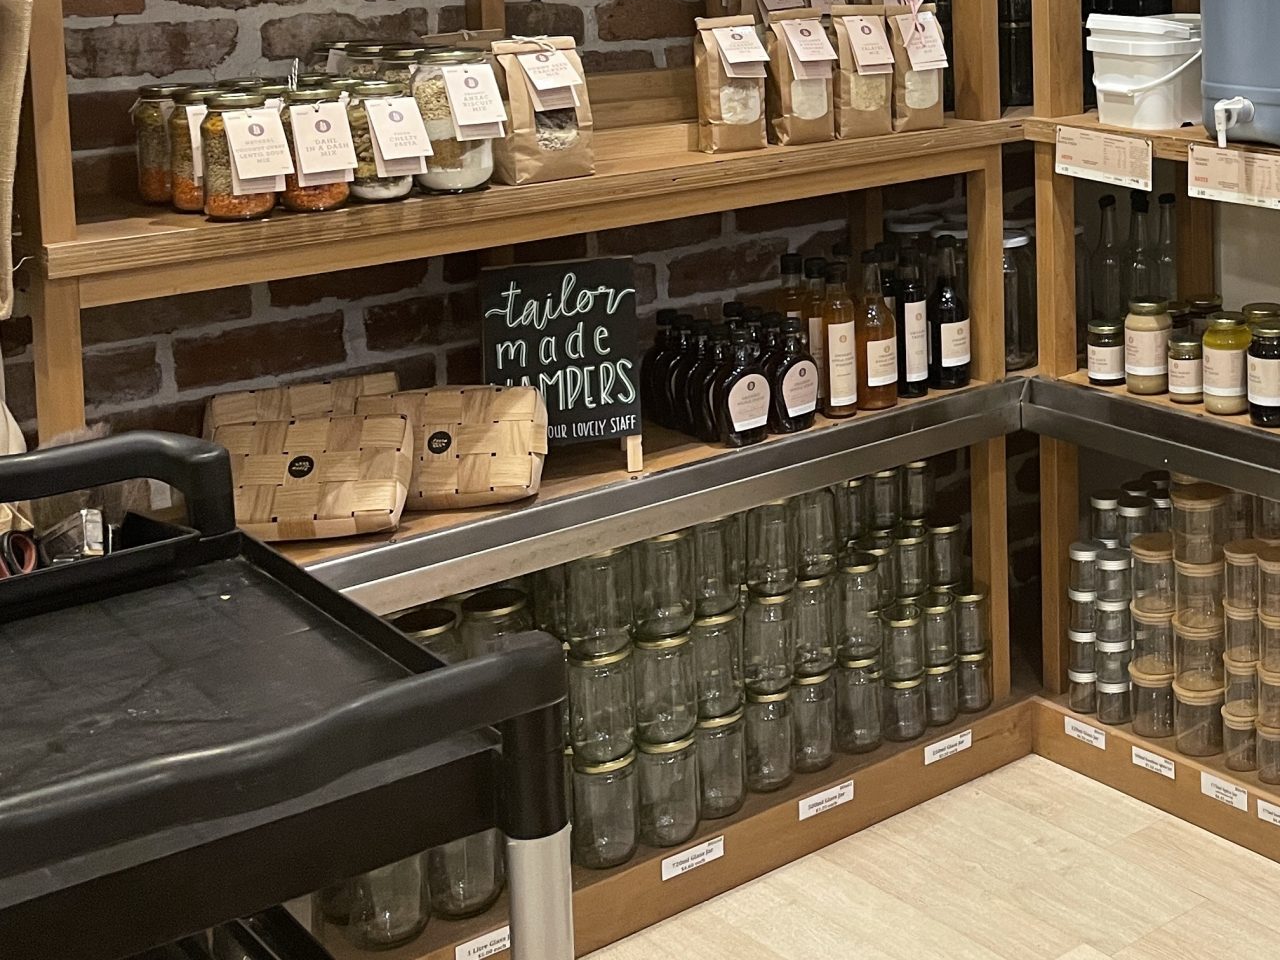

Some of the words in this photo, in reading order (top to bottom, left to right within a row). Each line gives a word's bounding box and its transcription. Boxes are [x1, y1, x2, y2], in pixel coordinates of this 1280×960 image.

[484, 272, 636, 330] tailor
[495, 321, 611, 370] made
[490, 358, 636, 411] MPERS
[572, 419, 607, 438] LOVELY
[610, 414, 636, 434] STAFF
[472, 944, 489, 954] Litre
[489, 936, 506, 947] Glass
